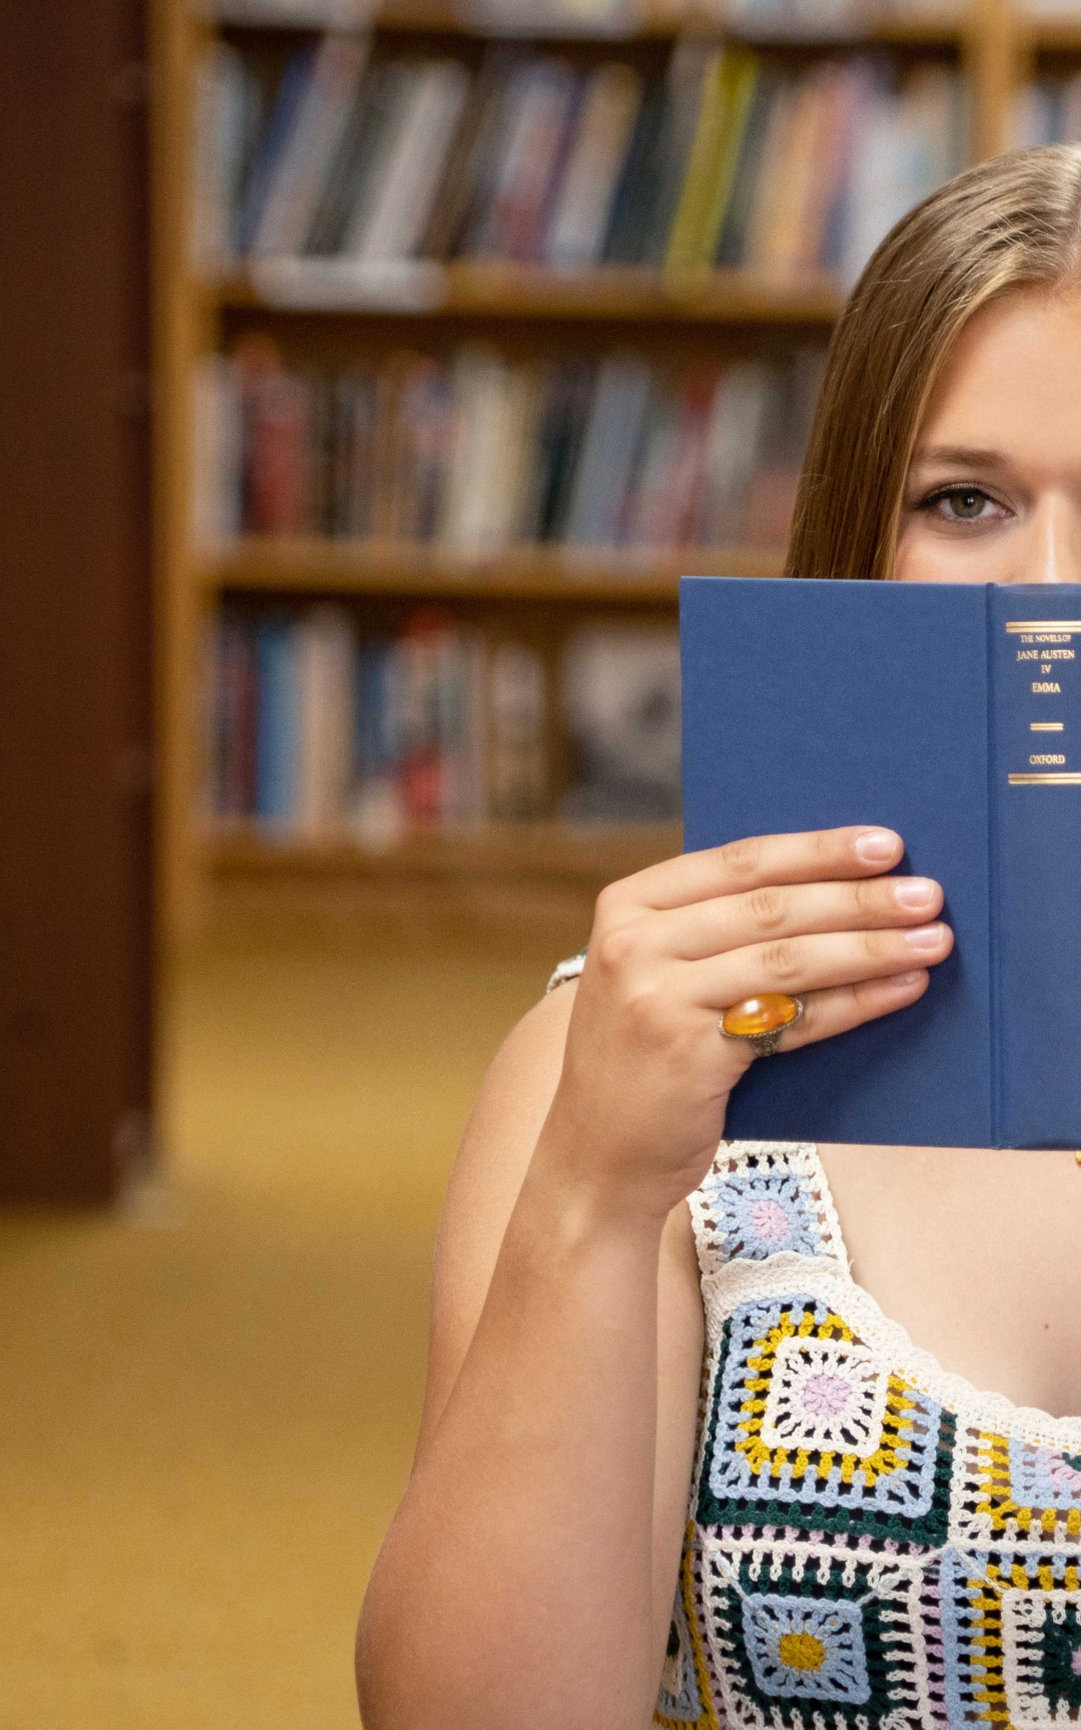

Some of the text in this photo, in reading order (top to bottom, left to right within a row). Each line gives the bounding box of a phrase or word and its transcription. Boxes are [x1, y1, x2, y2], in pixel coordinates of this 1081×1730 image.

[1020, 634, 1072, 643] THE NOVELS OF
[1016, 649, 1075, 661] JANE AUSTEN
[1041, 664, 1052, 674] IV
[1032, 682, 1061, 693] EMMA
[1029, 754, 1066, 765] OXFORD
